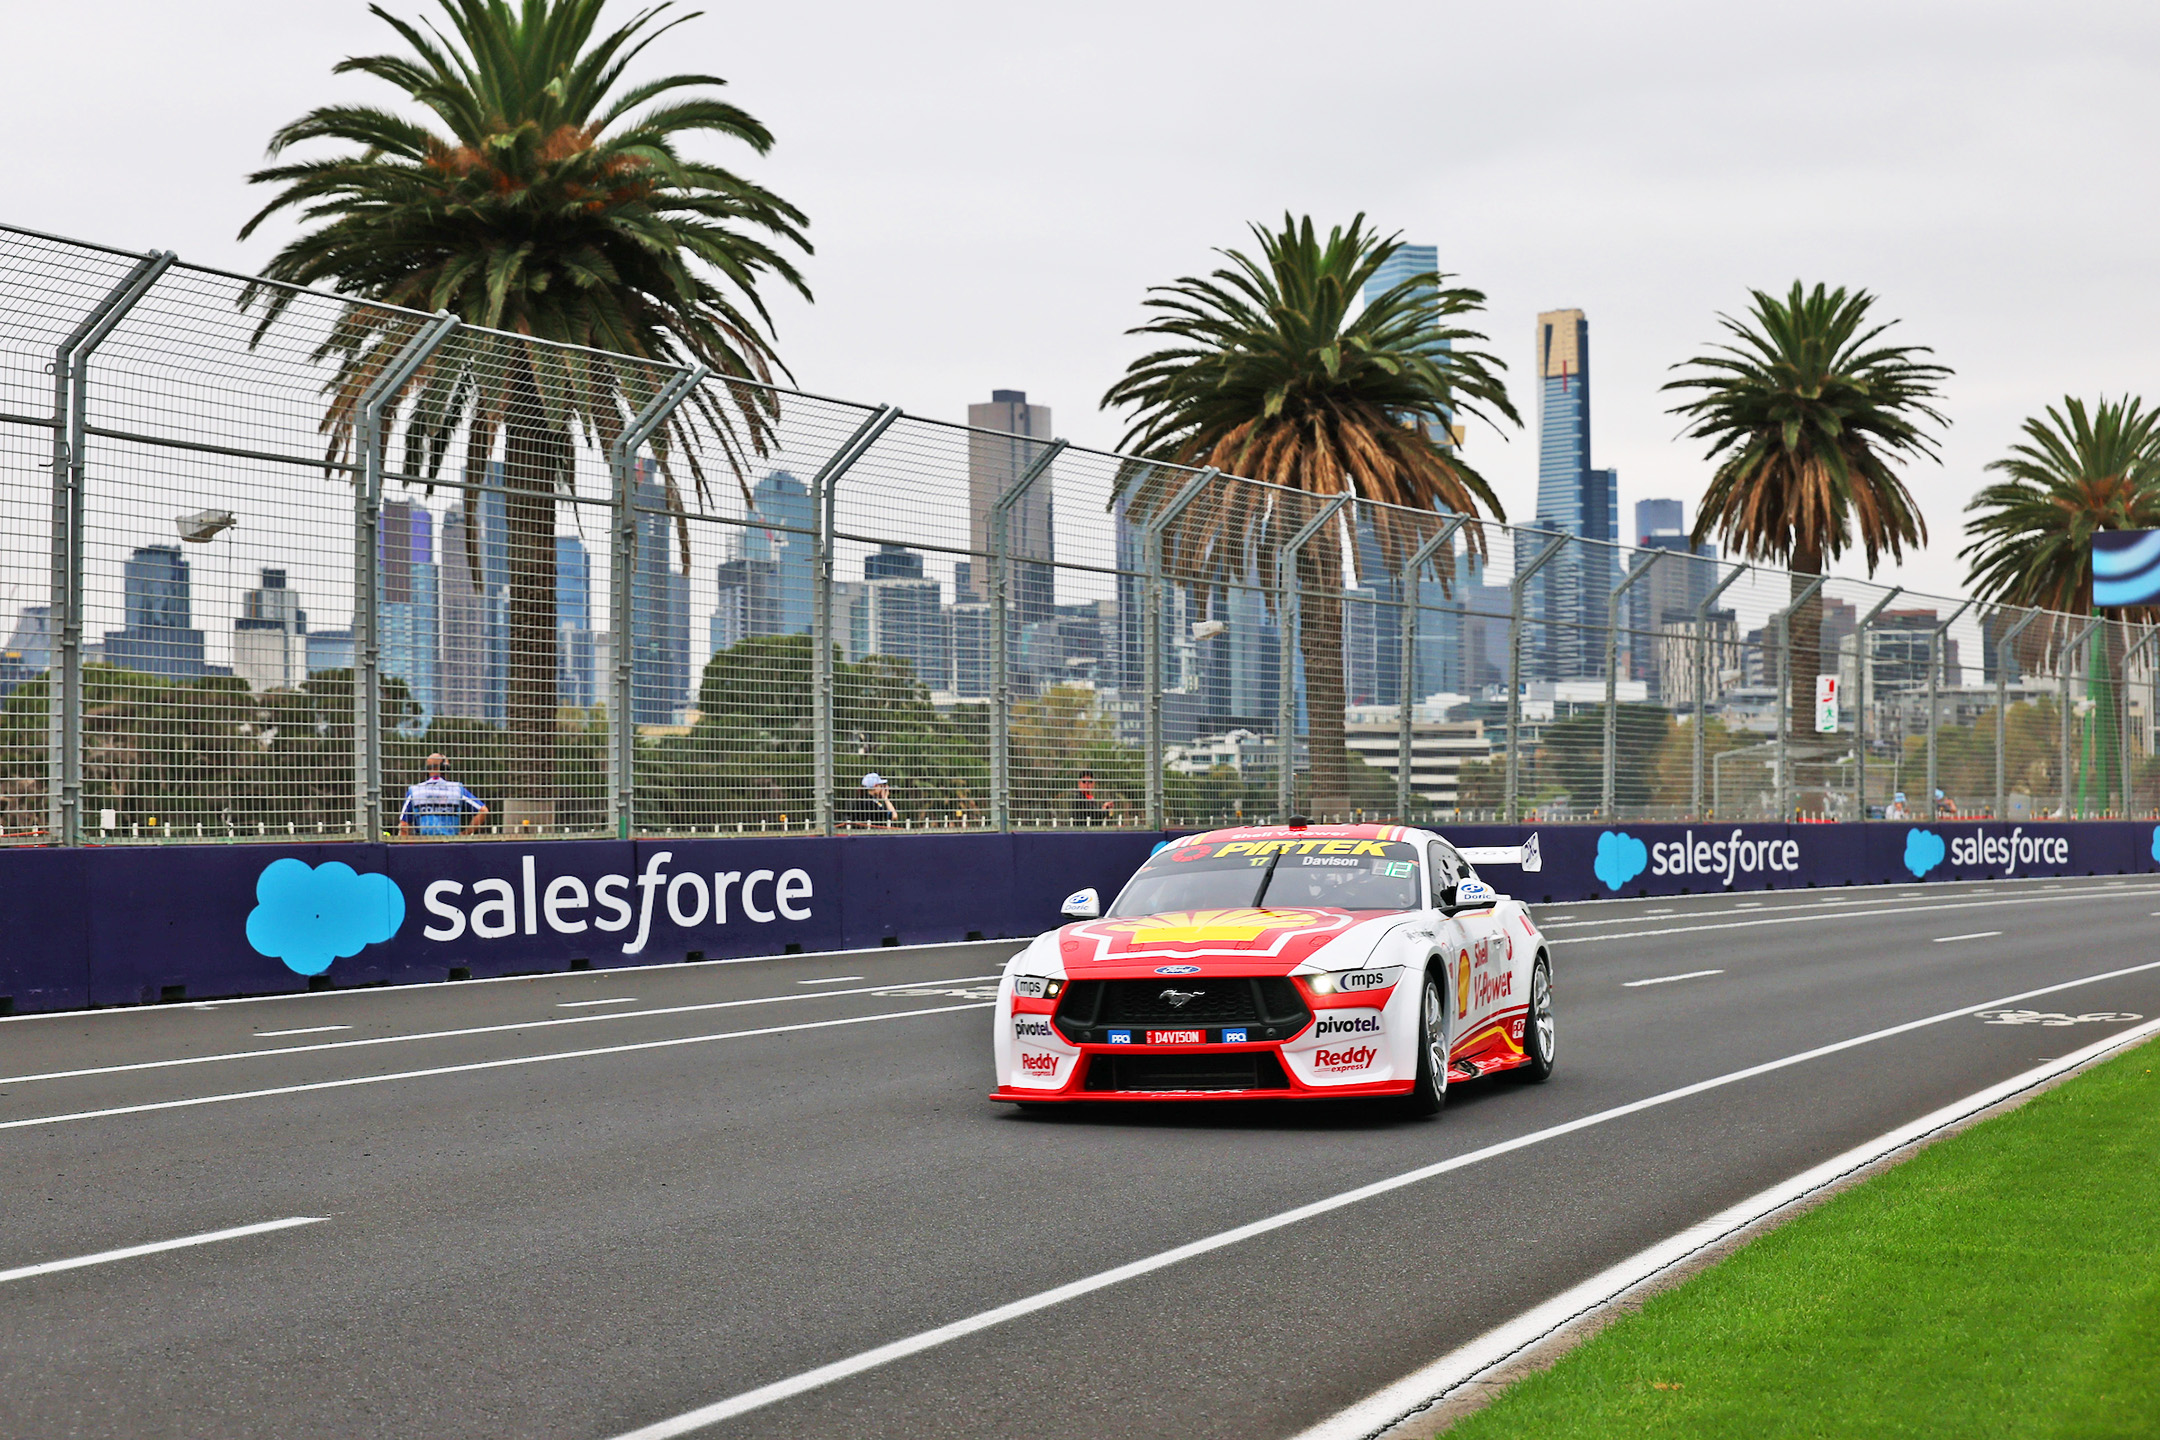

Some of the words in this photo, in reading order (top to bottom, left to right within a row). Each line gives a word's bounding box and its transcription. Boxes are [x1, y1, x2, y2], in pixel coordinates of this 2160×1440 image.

[1231, 831, 1273, 839] Shell
[1213, 839, 1396, 858] PIRTEK
[1651, 830, 1799, 885] salesforce
[1951, 827, 2069, 875] salesforce
[1249, 857, 1268, 867] 17
[1302, 856, 1359, 867] Davison
[423, 851, 813, 954] salesforce
[1474, 937, 1489, 968] Shell
[1020, 981, 1041, 995] mps
[1351, 972, 1384, 989] mps
[1474, 970, 1513, 1010] V-Power
[1315, 1015, 1380, 1038] pivotel.
[1111, 1034, 1131, 1044] PPQ
[1226, 1032, 1247, 1043] PPQ
[1022, 1053, 1059, 1076] Reddy
[1314, 1045, 1378, 1069] Reddy
[1331, 1064, 1364, 1073] express
